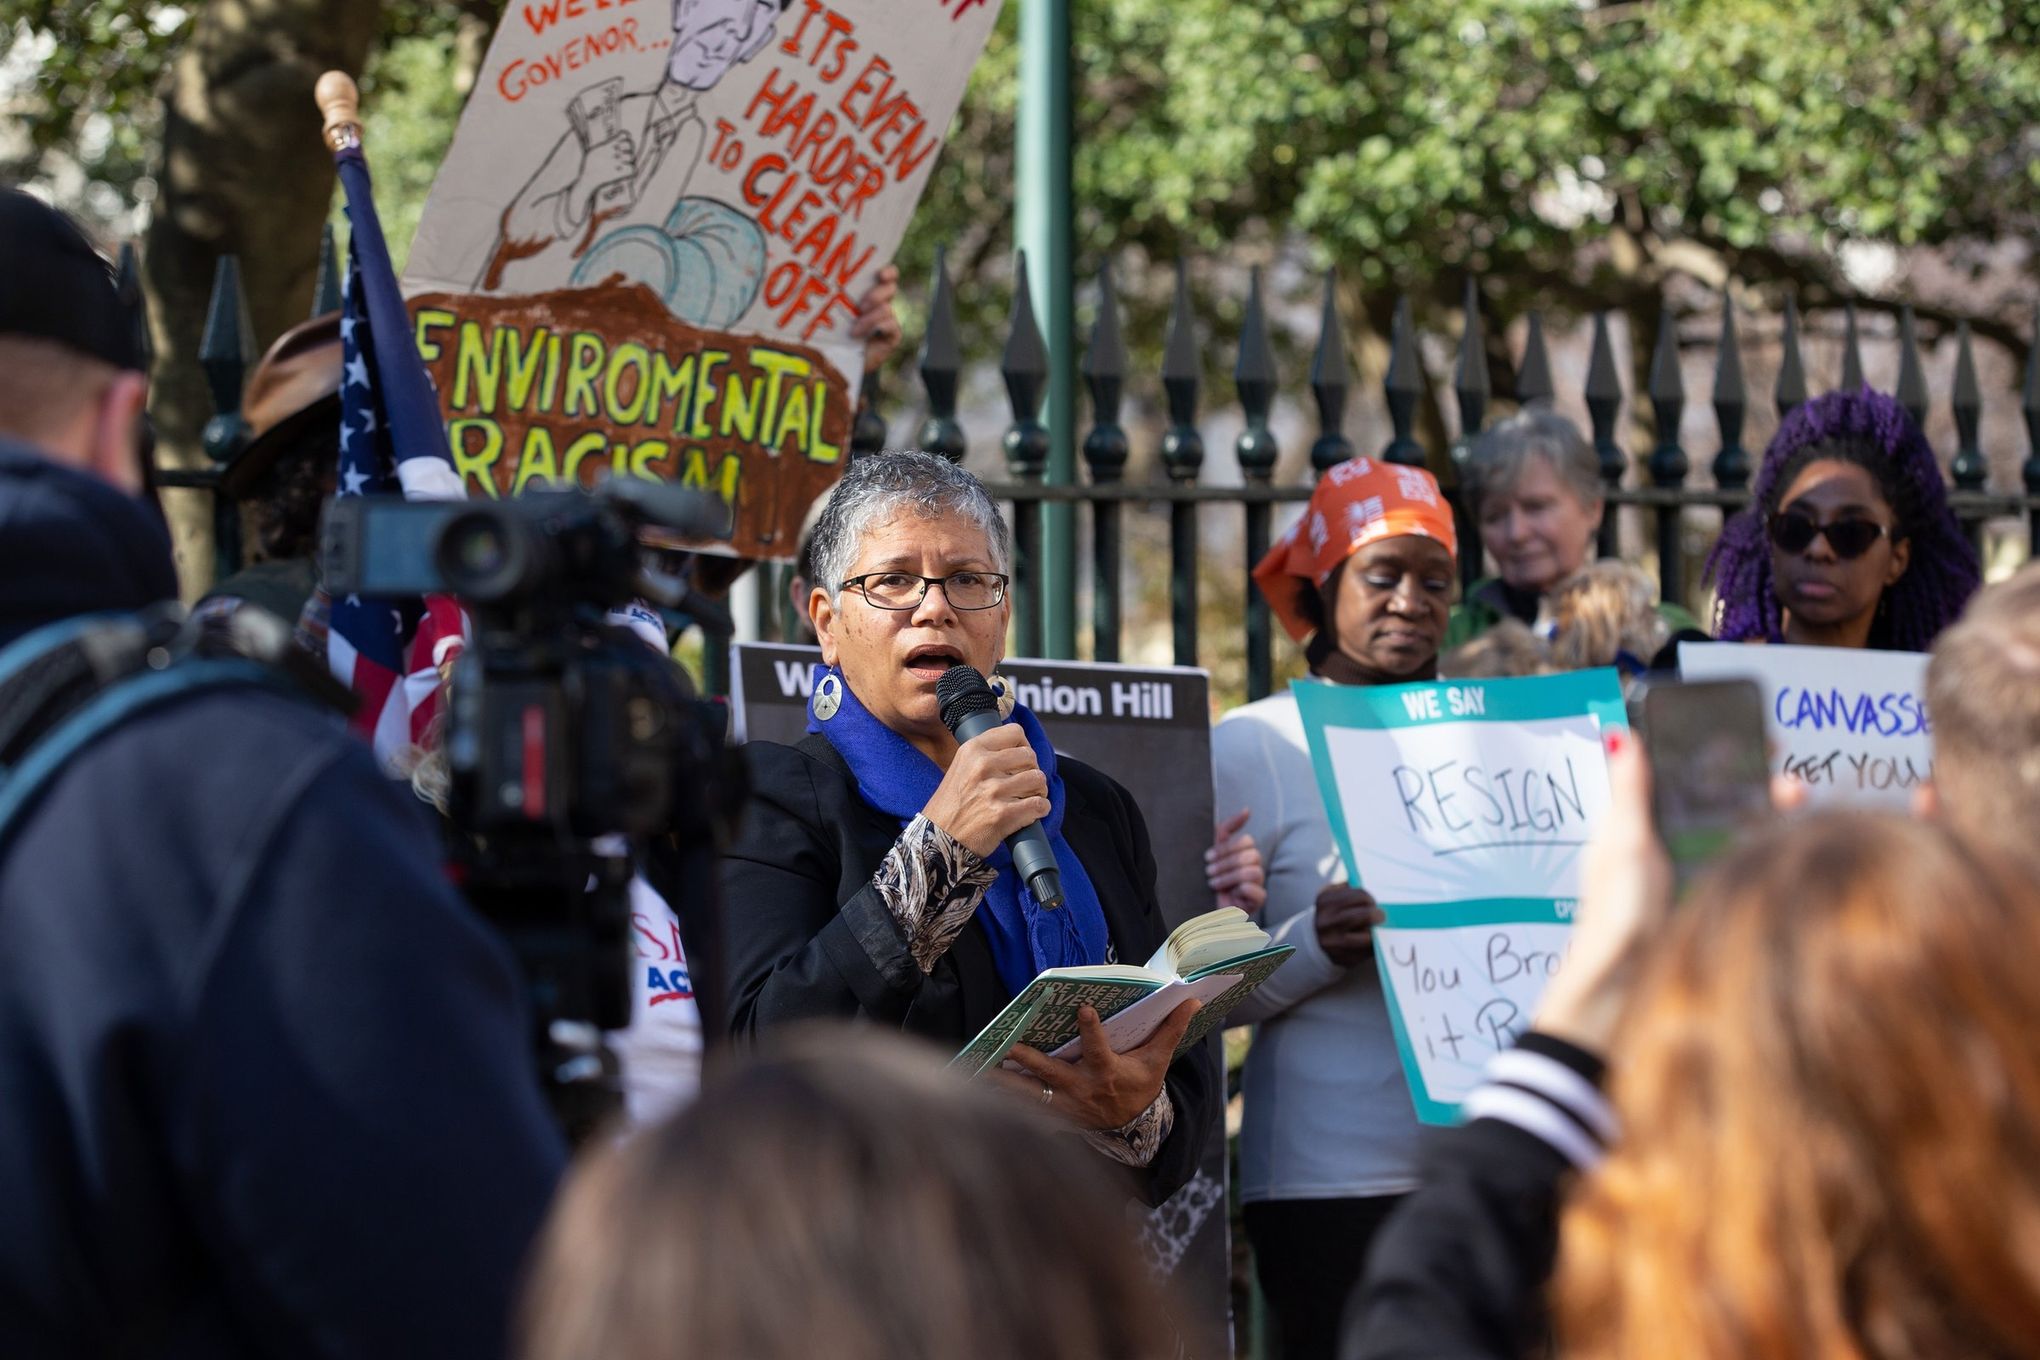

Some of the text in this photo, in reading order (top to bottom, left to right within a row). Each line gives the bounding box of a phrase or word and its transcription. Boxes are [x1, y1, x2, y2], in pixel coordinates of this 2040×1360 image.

[523, 0, 642, 36] WE
[497, 17, 670, 103] GOVENOR...
[781, 0, 938, 182] ITS EVEN
[743, 67, 885, 222] HARDER
[708, 116, 877, 287] TO CLEAN
[764, 261, 862, 342] OFF
[415, 308, 842, 463] ENVIROMENTAL
[450, 417, 740, 503] RACISM
[1111, 681, 1173, 719] Hill
[1402, 686, 1486, 721] WE SAY
[1393, 755, 1585, 833] RESIGN
[1783, 749, 1936, 790] GET YOU
[1076, 983, 1110, 996] THE
[1390, 932, 1573, 995] You Bro
[1031, 1031, 1073, 1044] BAC
[1420, 1012, 1465, 1060] it
